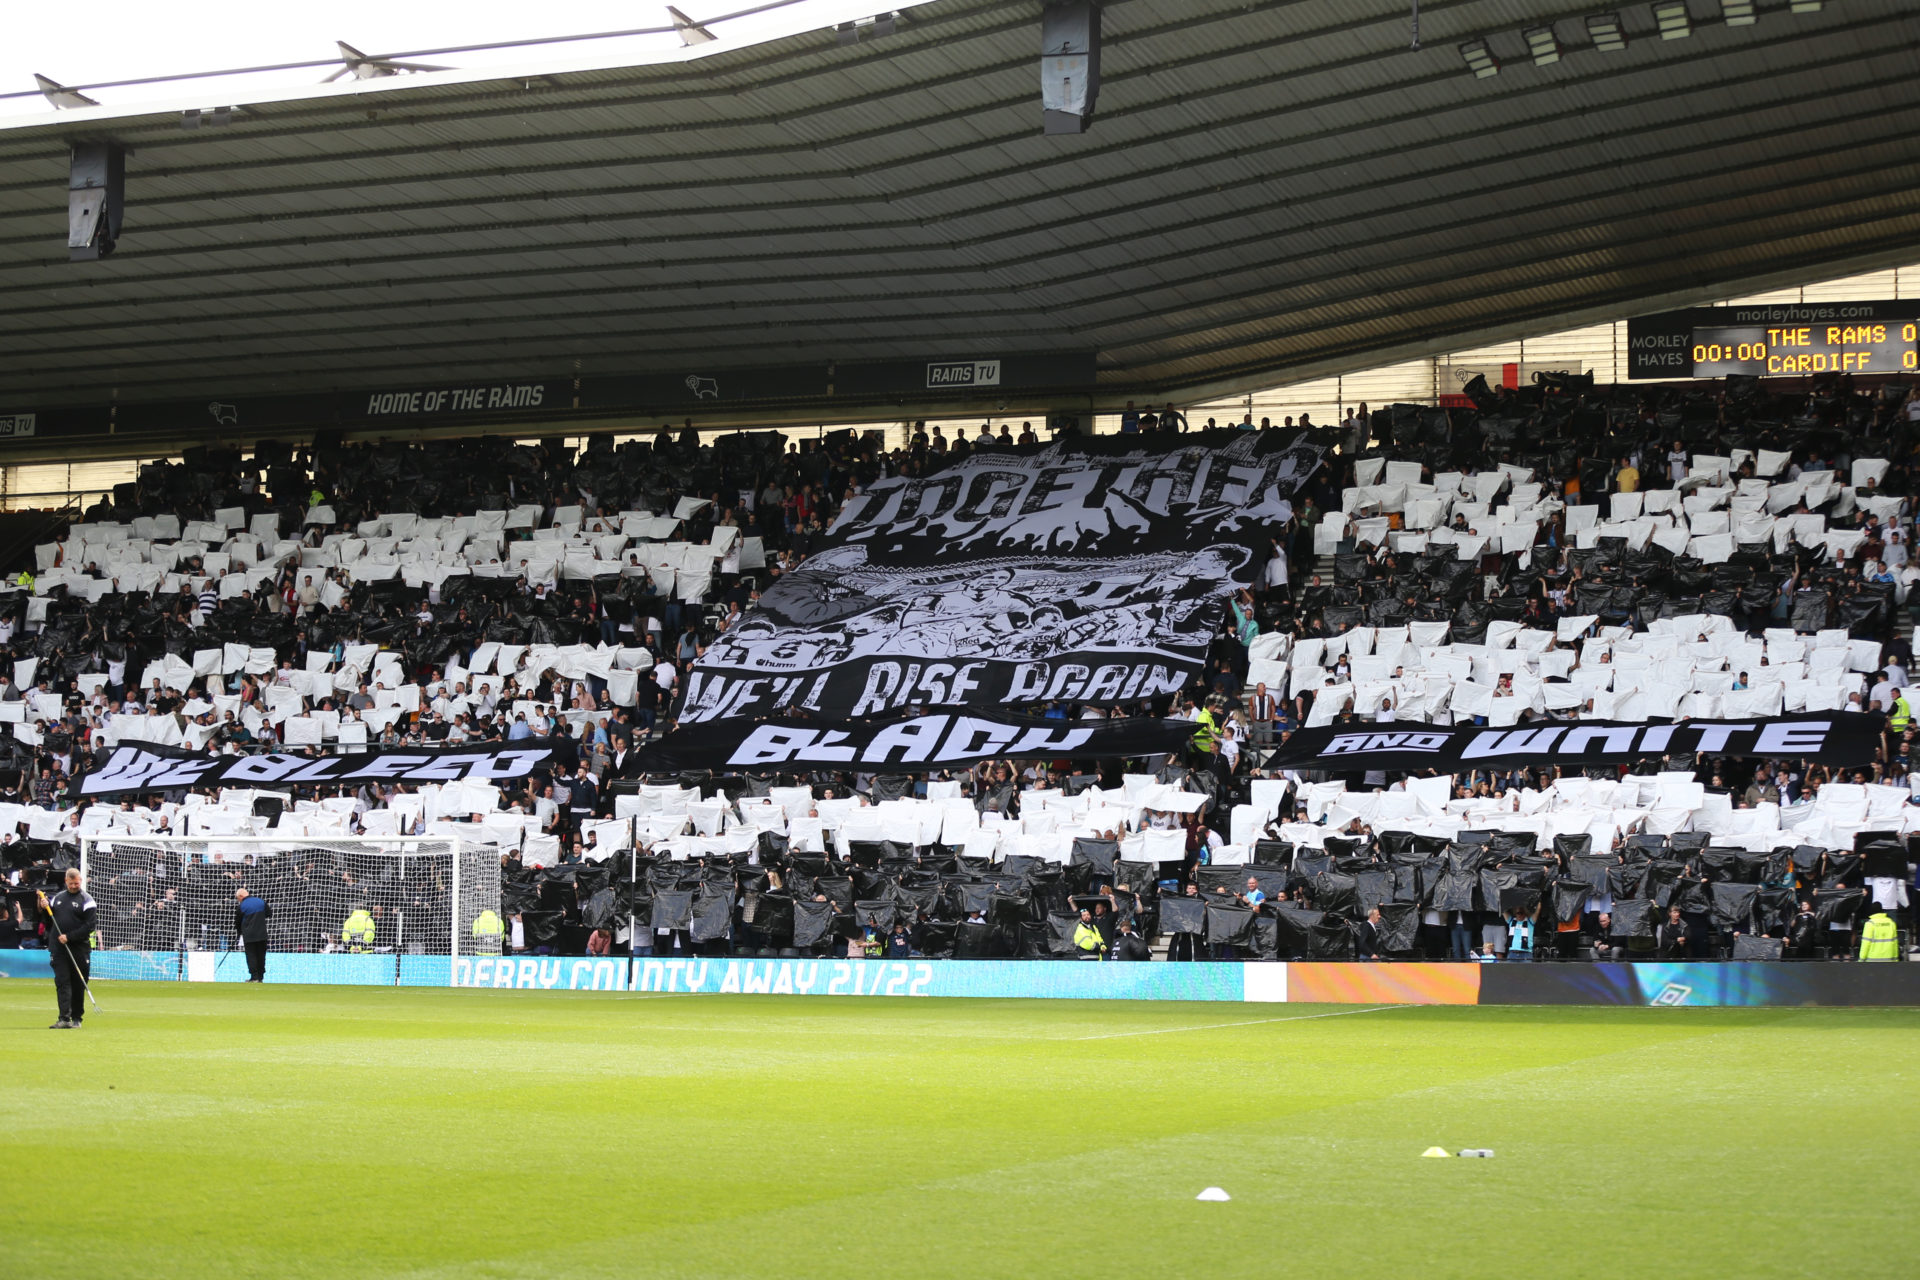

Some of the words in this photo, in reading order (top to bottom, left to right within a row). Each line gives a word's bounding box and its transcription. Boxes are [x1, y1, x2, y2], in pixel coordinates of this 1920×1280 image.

[1736, 305, 1873, 323] morleyhayes.com
[1631, 335, 1689, 349] MORLEY
[1767, 328, 1811, 347] THE
[1826, 324, 1887, 345] RAMS
[1902, 323, 1917, 343] 0
[1638, 353, 1684, 366] HAYES
[1693, 342, 1767, 363] 00:00
[1767, 352, 1872, 373] CARDIFF
[1902, 350, 1917, 369] 0
[931, 365, 972, 383] RAMS
[978, 364, 996, 380] TV
[367, 391, 422, 415] HOME
[423, 390, 449, 412] OF
[451, 388, 486, 410] THE
[487, 385, 545, 408] RAMS
[18, 418, 32, 432] TV
[853, 446, 1320, 526] TOGETHER
[677, 671, 832, 724] WE'LL
[850, 661, 988, 716] RISE
[999, 661, 1189, 703] AGAIN
[726, 714, 1095, 765] BLACK
[1322, 733, 1449, 754] AND
[1460, 721, 1832, 760] WHITE
[80, 746, 220, 794] WE
[219, 748, 553, 782] BLEED
[456, 957, 561, 989] DERBY
[570, 960, 709, 992] COUNTY
[719, 961, 819, 995] AWAY
[827, 962, 934, 997] 21/22
